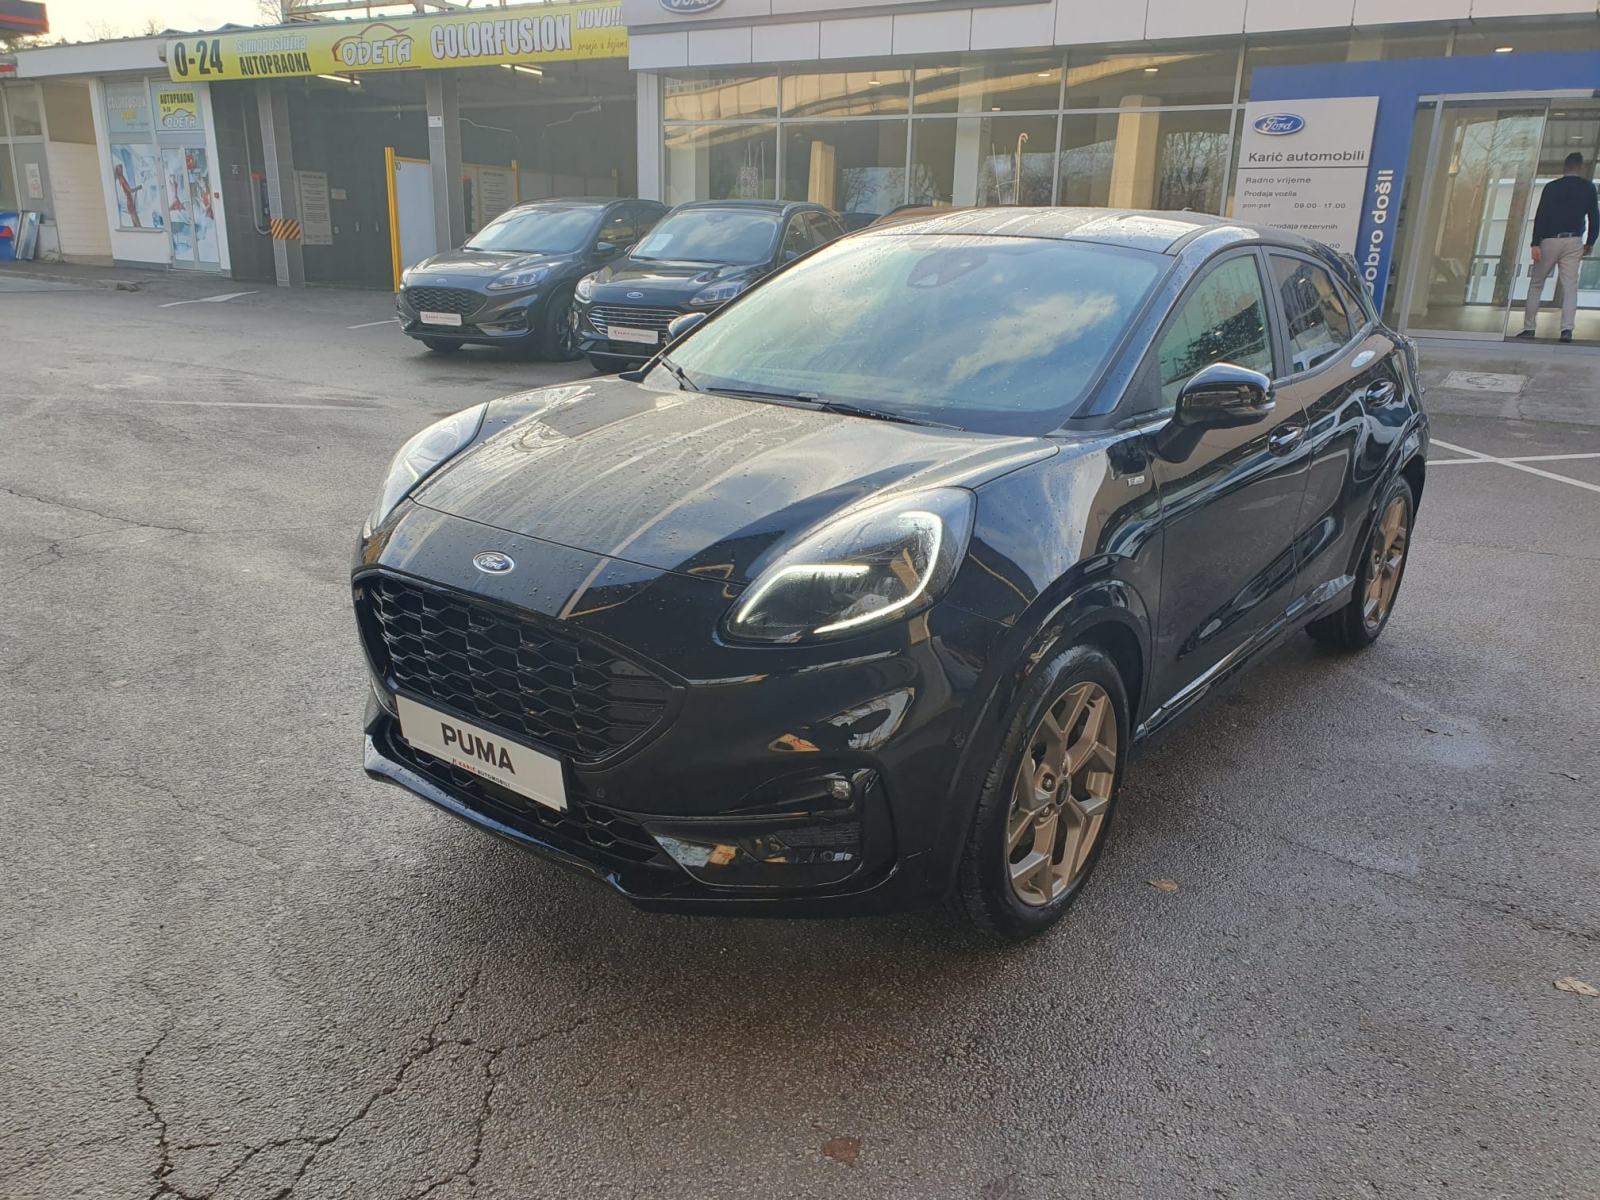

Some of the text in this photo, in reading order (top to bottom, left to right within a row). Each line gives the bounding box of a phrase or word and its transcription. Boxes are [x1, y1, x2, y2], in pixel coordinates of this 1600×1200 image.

[430, 15, 572, 59] COLORFUSION
[174, 39, 224, 76] 0-24
[239, 52, 312, 75] AUTOPRAONA
[341, 38, 412, 66] ODETA
[1262, 116, 1295, 132] Ford
[1248, 150, 1365, 163] Karić automobili
[1276, 176, 1312, 185] vrijeme
[1372, 170, 1394, 224] došli
[441, 722, 516, 775] PUMA
